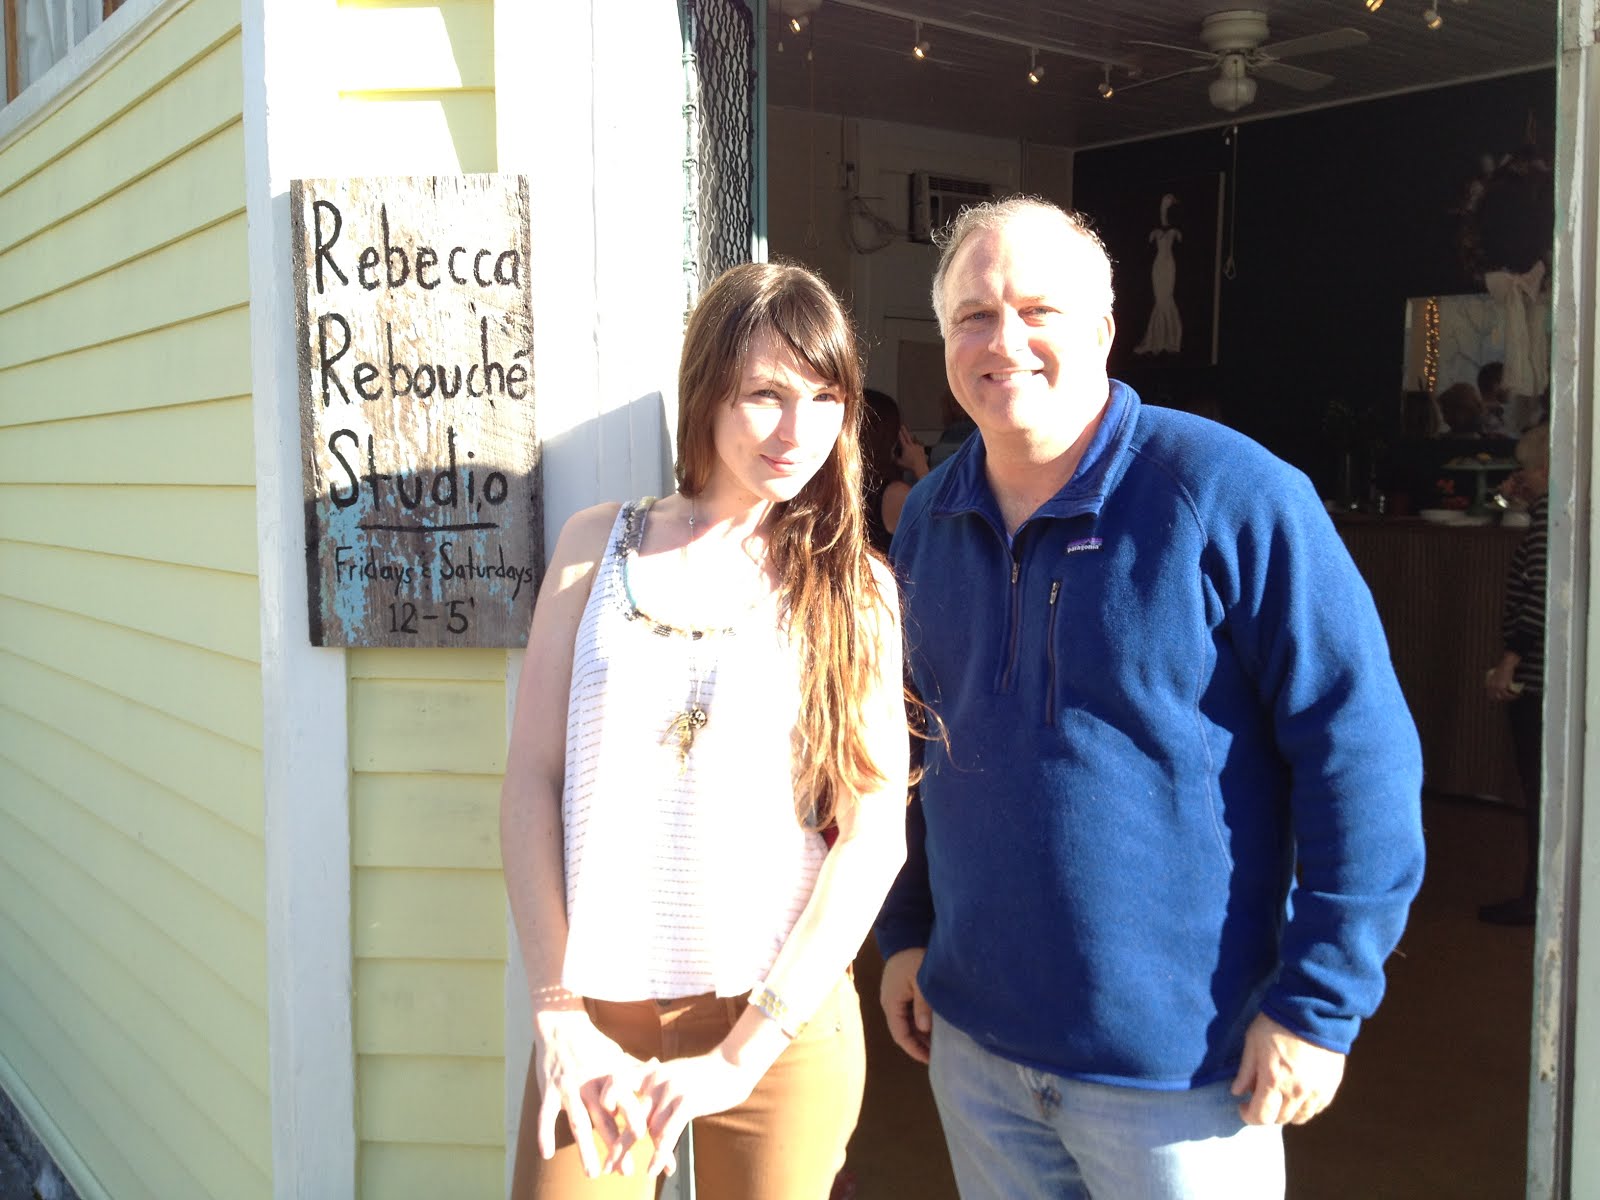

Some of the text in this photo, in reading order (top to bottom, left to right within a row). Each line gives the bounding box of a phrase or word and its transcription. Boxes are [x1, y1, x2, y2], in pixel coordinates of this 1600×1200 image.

[313, 200, 521, 294] Rebecca
[318, 313, 529, 407] Rebouché
[328, 426, 508, 512] Studio
[335, 546, 412, 596] Fridays
[439, 542, 533, 600] Saturdays
